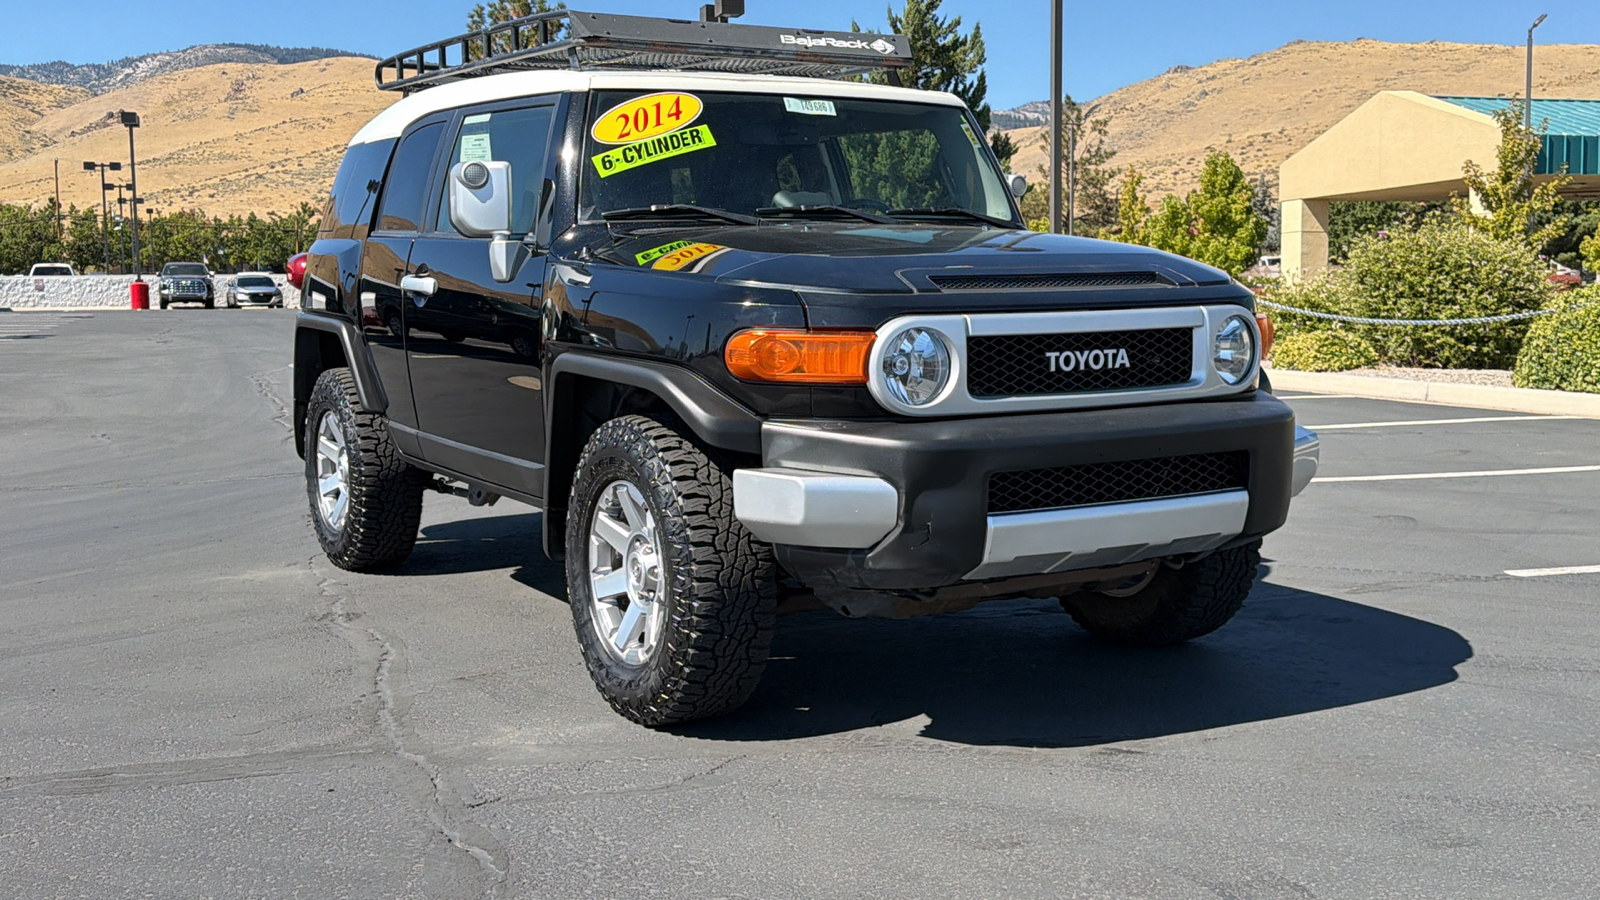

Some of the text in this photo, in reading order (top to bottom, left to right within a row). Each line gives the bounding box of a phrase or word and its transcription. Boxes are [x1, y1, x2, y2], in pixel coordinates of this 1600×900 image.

[779, 34, 871, 50] BajaRack
[615, 95, 683, 140] 2014
[601, 128, 705, 172] 6-CYLINDER
[1045, 348, 1131, 373] TOYOTA
